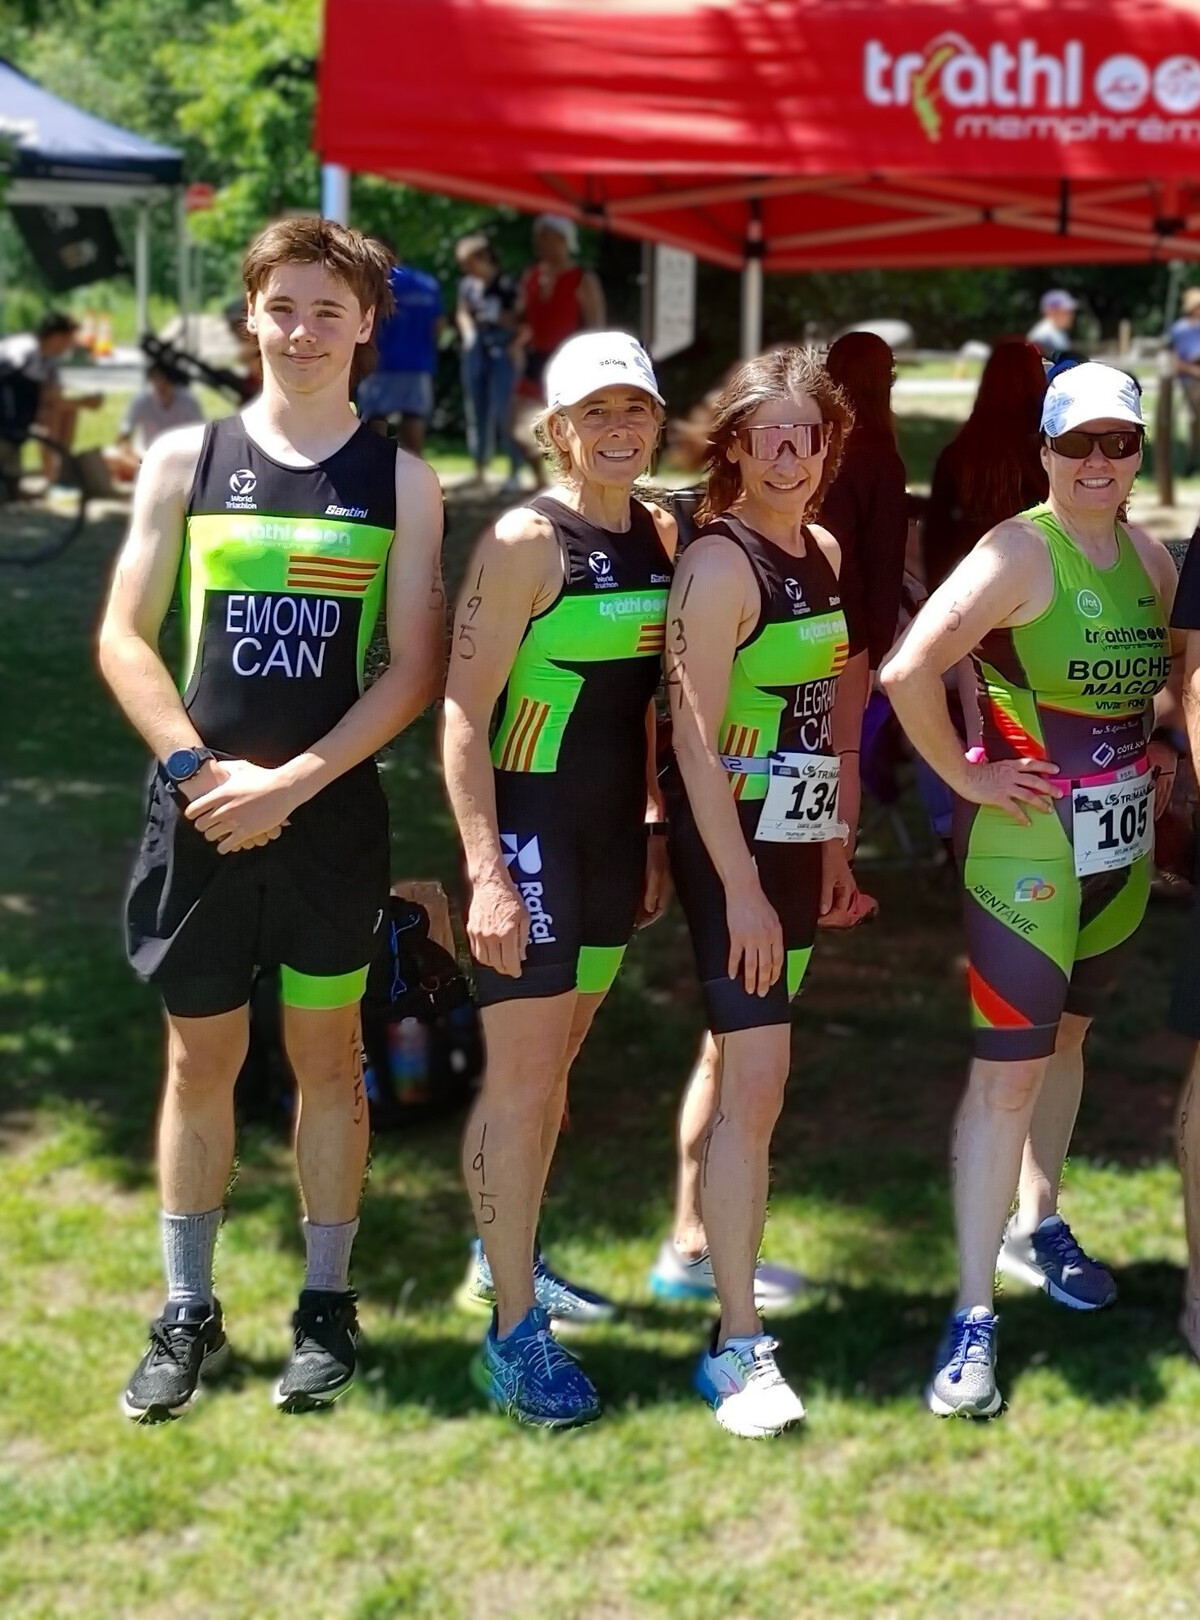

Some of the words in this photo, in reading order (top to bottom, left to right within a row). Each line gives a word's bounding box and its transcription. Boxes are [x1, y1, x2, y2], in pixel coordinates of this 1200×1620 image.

[225, 594, 341, 638] EMOND
[231, 636, 327, 678] CAN
[785, 779, 840, 821] 134
[1097, 797, 1149, 851] 105
[520, 880, 557, 944] Rafal
[472, 1121, 500, 1225] 195
